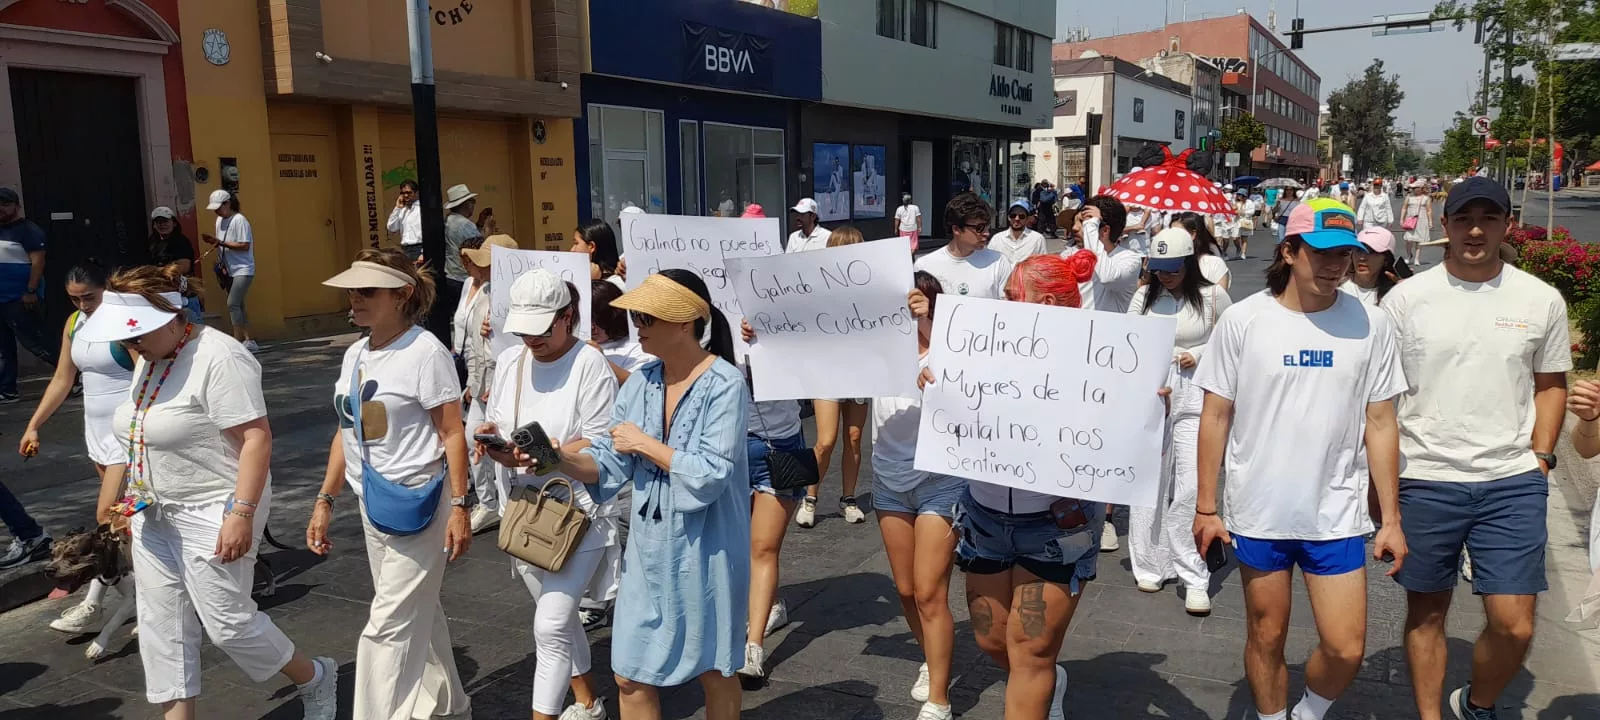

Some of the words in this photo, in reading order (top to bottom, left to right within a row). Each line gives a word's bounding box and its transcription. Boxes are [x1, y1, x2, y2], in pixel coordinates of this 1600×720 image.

[429, 0, 473, 25] CHE
[705, 44, 754, 74] BBVA
[989, 74, 1010, 98] Aldo
[1011, 79, 1033, 102] Conti
[1001, 104, 1021, 115] ITALIA
[363, 156, 379, 232] MICHELADAS
[629, 218, 686, 253] Galindo
[690, 238, 710, 251] no
[719, 231, 772, 258] puedes
[750, 268, 812, 303] Galindo
[819, 259, 872, 290] NO
[754, 311, 807, 335] Puedes
[815, 302, 912, 336] Cuidarnos
[946, 303, 1050, 360] Galindo
[1283, 354, 1298, 366] EL
[1299, 349, 1334, 368] CLUB
[941, 367, 1022, 411] Mujeres
[1033, 373, 1060, 401] de
[1082, 379, 1106, 405] la
[932, 408, 1000, 447] Capital
[1058, 426, 1104, 450] nos
[946, 446, 1037, 485] Sentimos
[1056, 452, 1136, 493] Seguras
